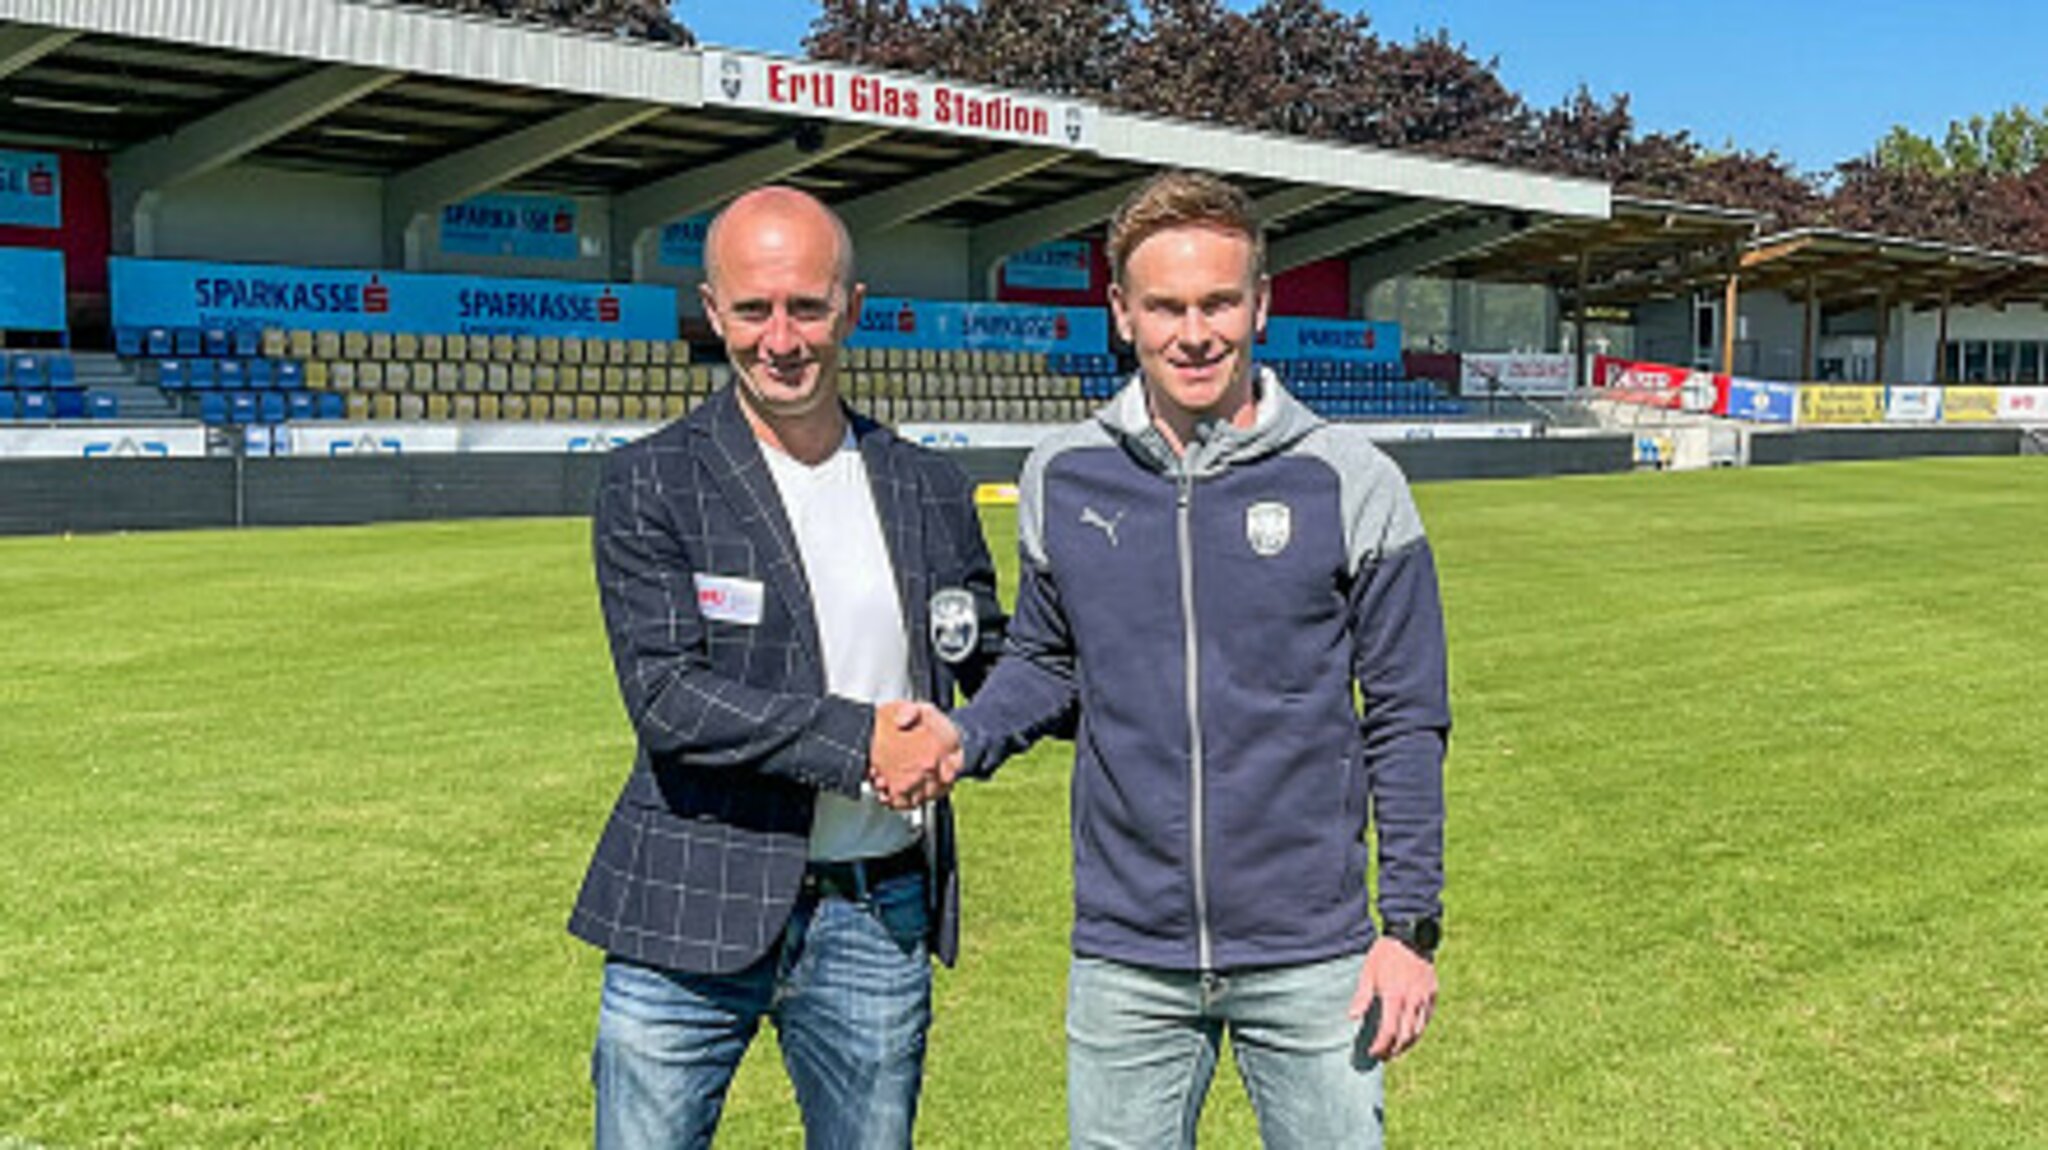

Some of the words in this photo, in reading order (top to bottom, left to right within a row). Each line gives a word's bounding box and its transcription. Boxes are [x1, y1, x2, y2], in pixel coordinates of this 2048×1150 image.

[767, 64, 834, 108] Ertl
[850, 75, 920, 118] Glas
[934, 87, 1049, 136] Stadion
[195, 278, 360, 313] SPARKASSE
[458, 288, 598, 322] SPARKASSE
